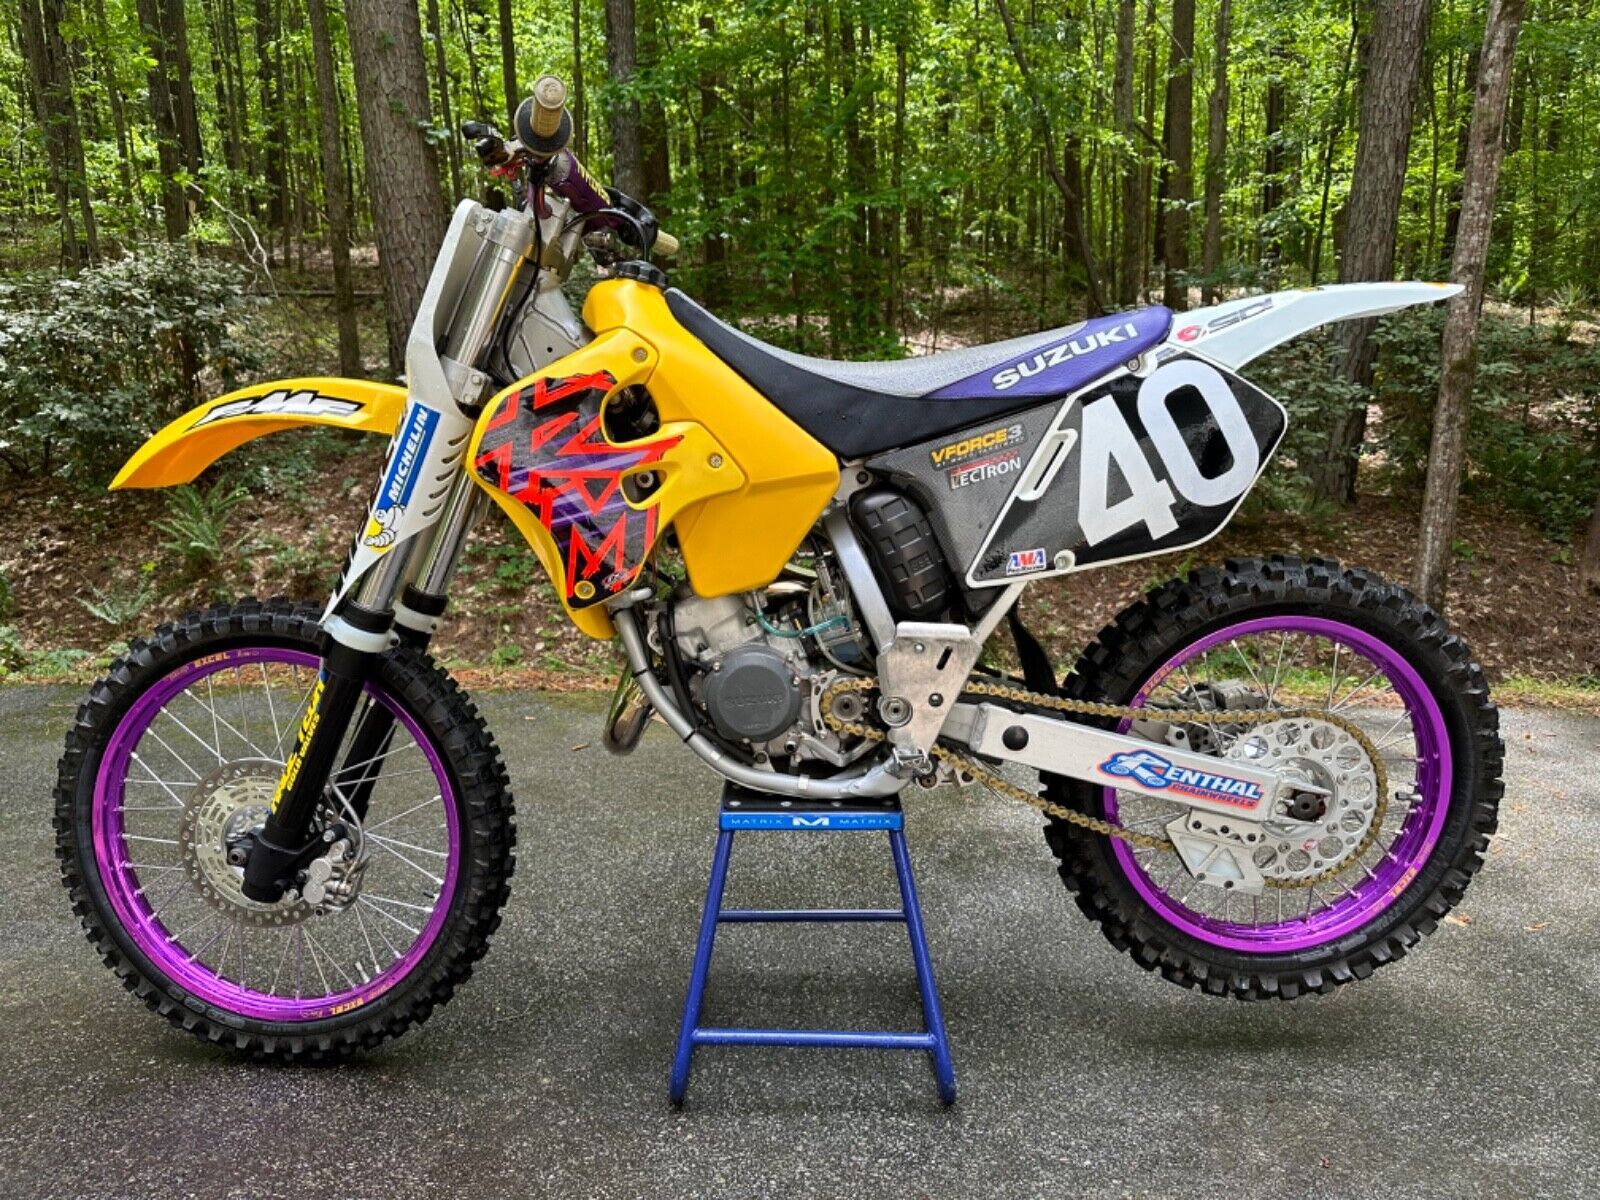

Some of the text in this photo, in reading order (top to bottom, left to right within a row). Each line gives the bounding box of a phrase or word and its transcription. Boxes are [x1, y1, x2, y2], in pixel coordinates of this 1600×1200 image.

[991, 322, 1139, 391] SUZUKI
[388, 407, 428, 502] MICHELIN
[1077, 359, 1260, 546] 40
[1100, 750, 1264, 800] RENTHAL
